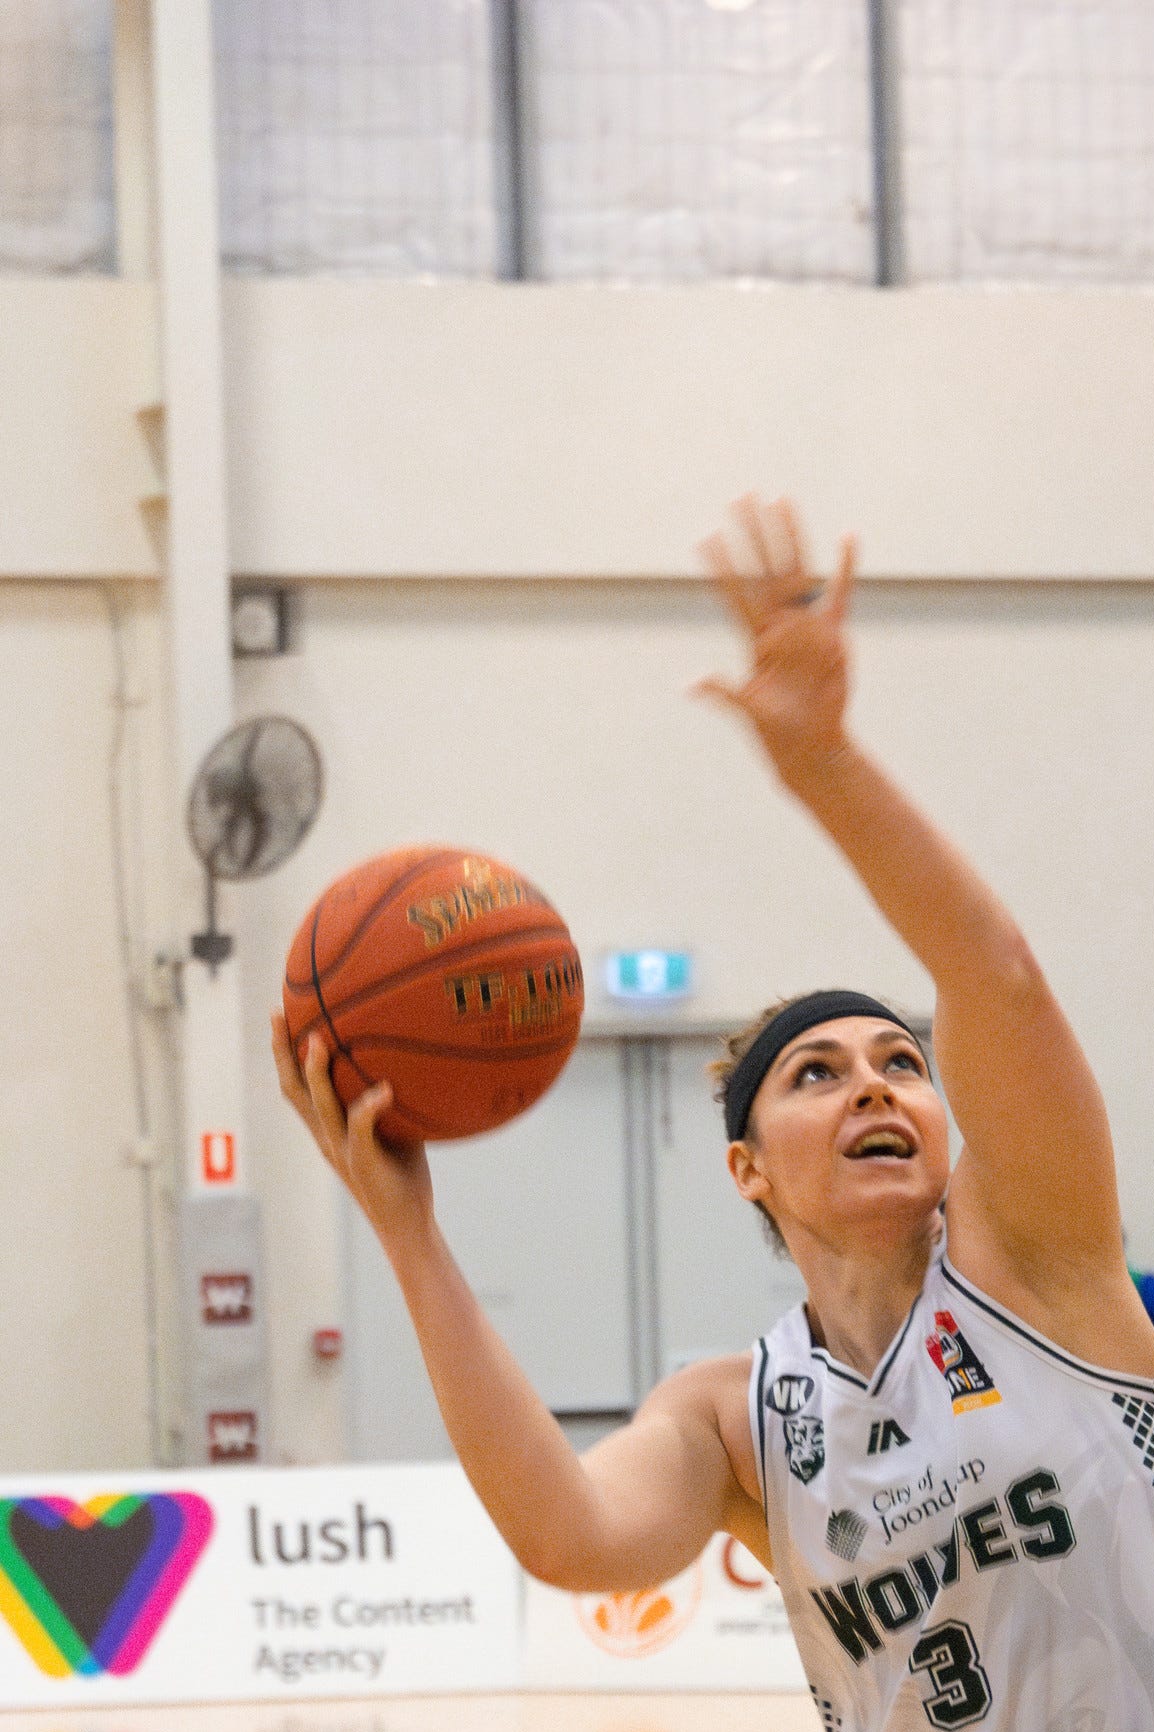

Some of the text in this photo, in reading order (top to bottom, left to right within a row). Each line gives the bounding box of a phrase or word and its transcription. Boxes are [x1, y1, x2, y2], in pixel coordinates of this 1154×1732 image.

[872, 1464, 933, 1513] City of
[247, 1502, 396, 1566] lush
[251, 1596, 477, 1631] The Content
[254, 1646, 386, 1684] Agency
[908, 1618, 992, 1732] 3
